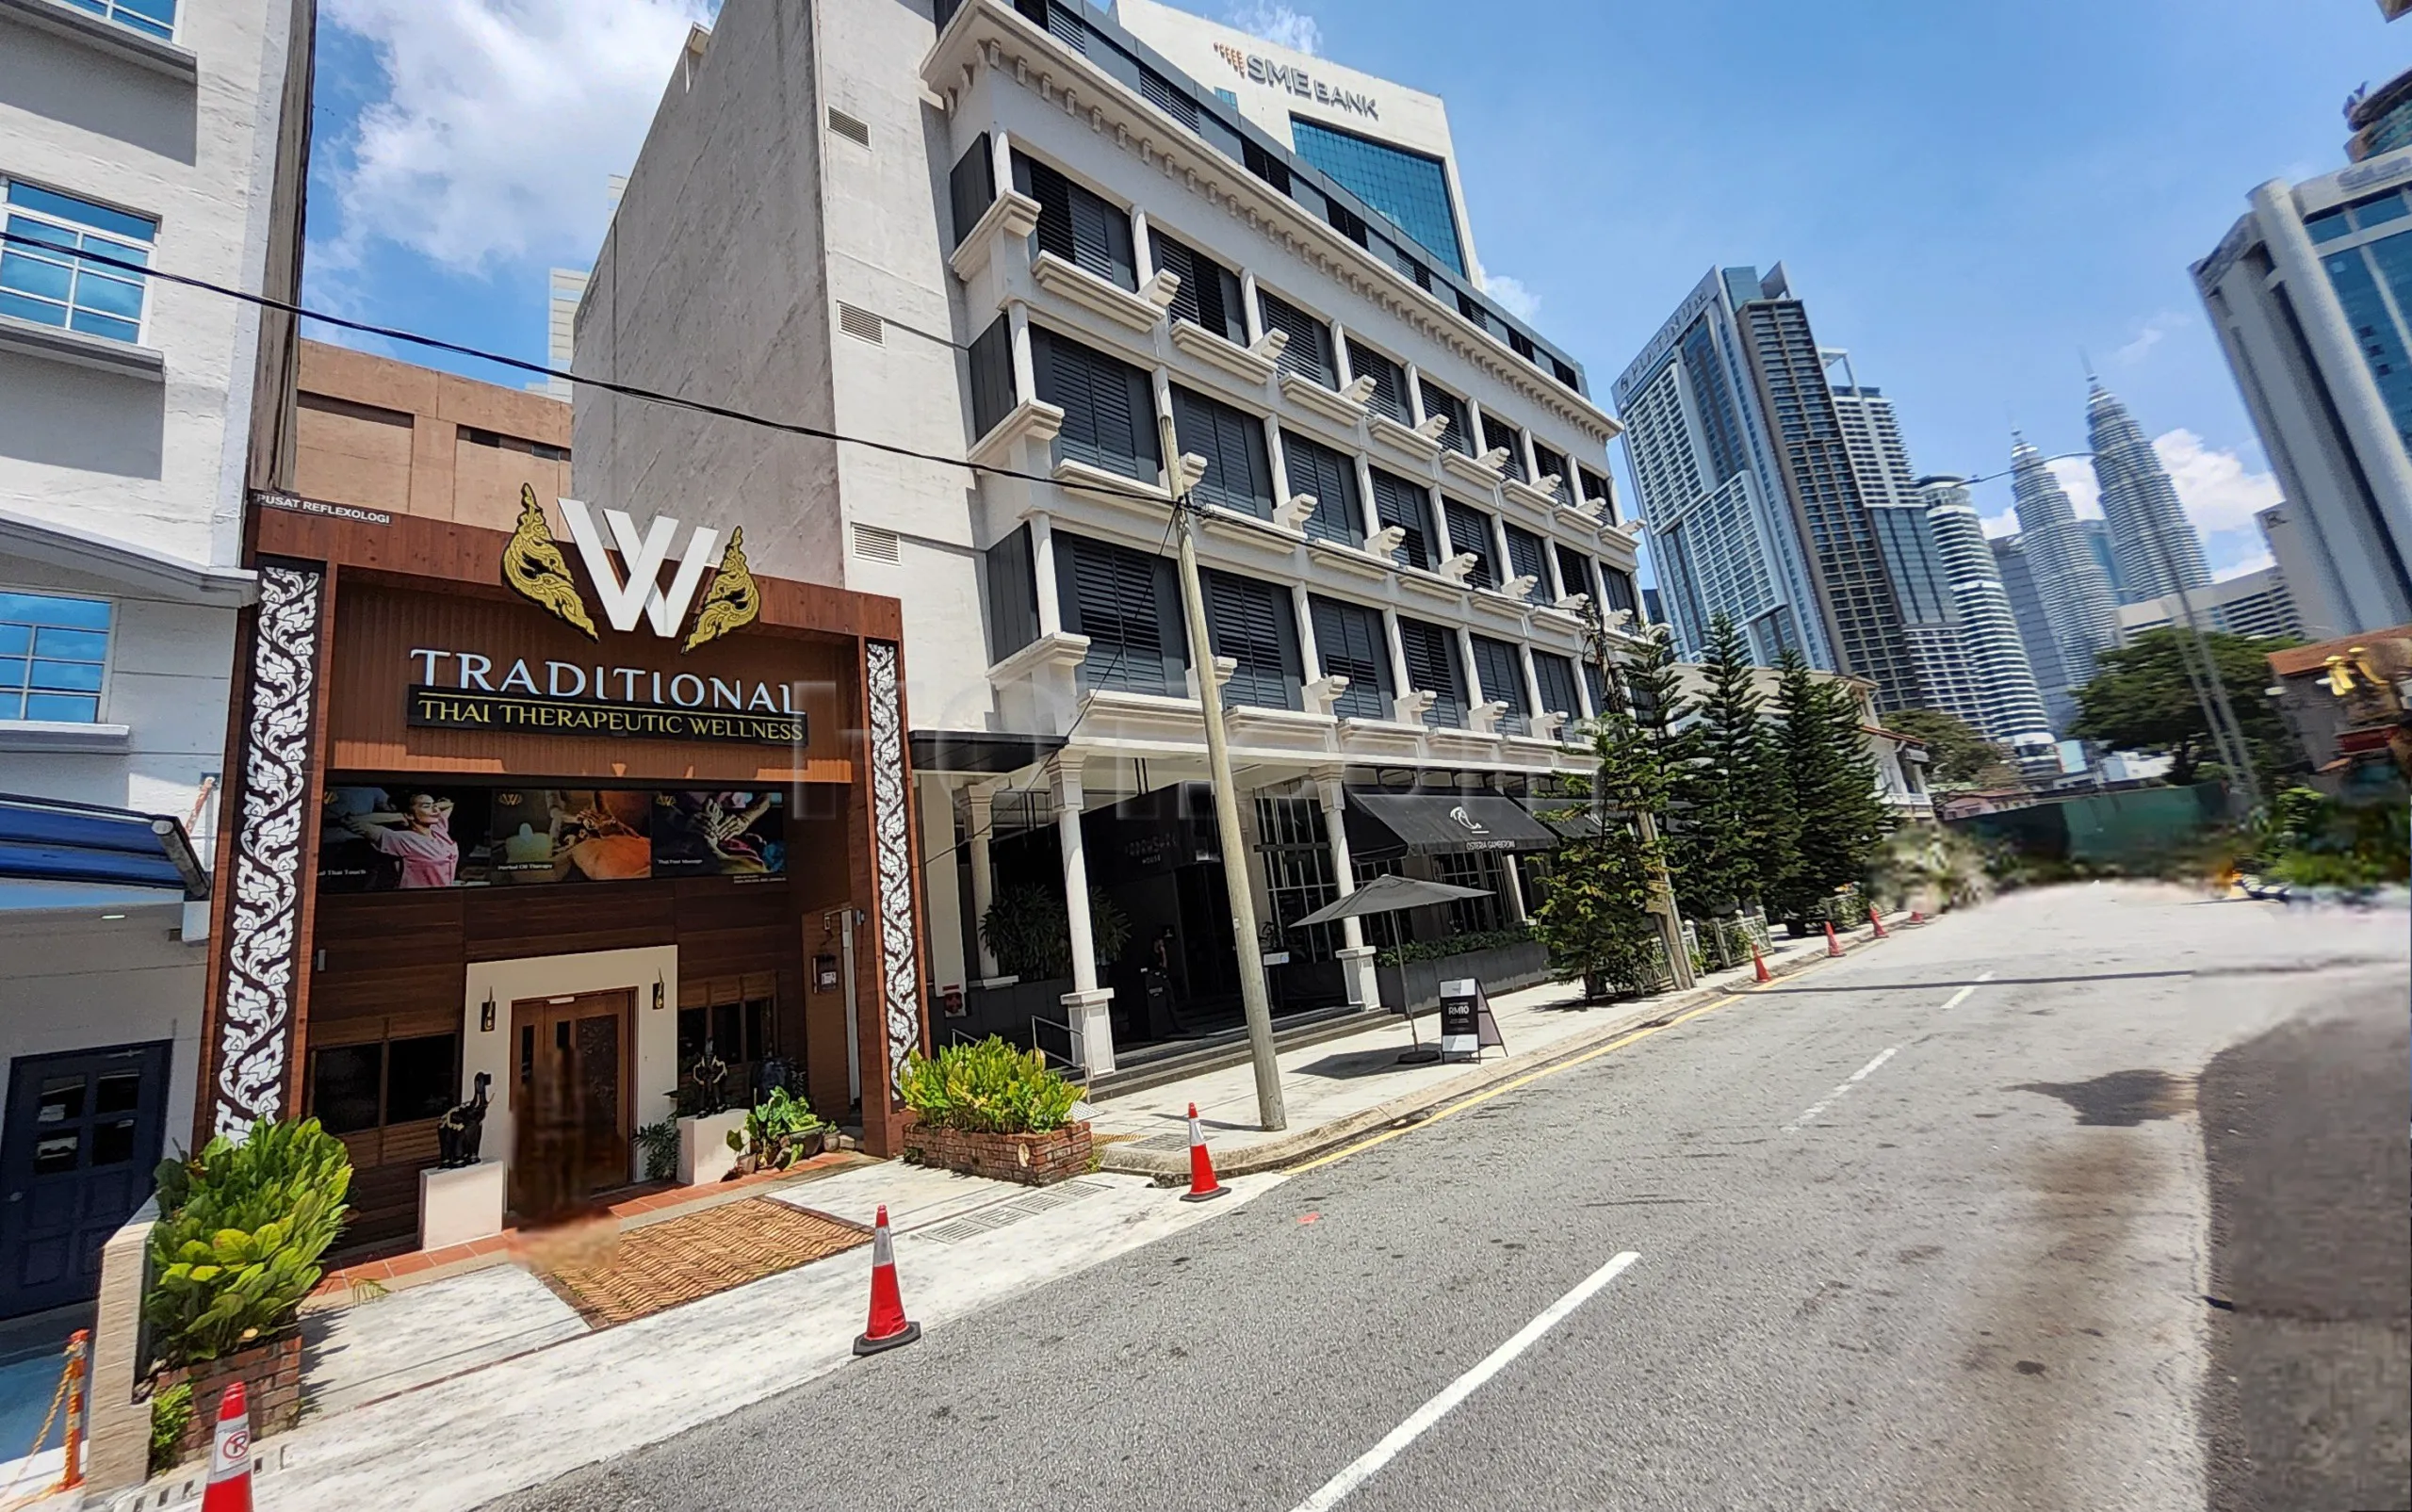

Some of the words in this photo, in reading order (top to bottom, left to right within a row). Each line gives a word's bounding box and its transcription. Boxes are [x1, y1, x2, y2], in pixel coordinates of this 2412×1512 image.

[1247, 55, 1312, 100] SME
[1313, 79, 1380, 122] BANK
[1631, 289, 1707, 381] PLATINUM
[256, 493, 301, 509] PUSAT
[302, 501, 390, 524] REFLEXOLOGI
[410, 648, 807, 715] TRADITIONAL
[418, 699, 491, 723] THAI
[498, 704, 683, 734] THERAPEUTIC
[688, 717, 805, 740] WELLNESS
